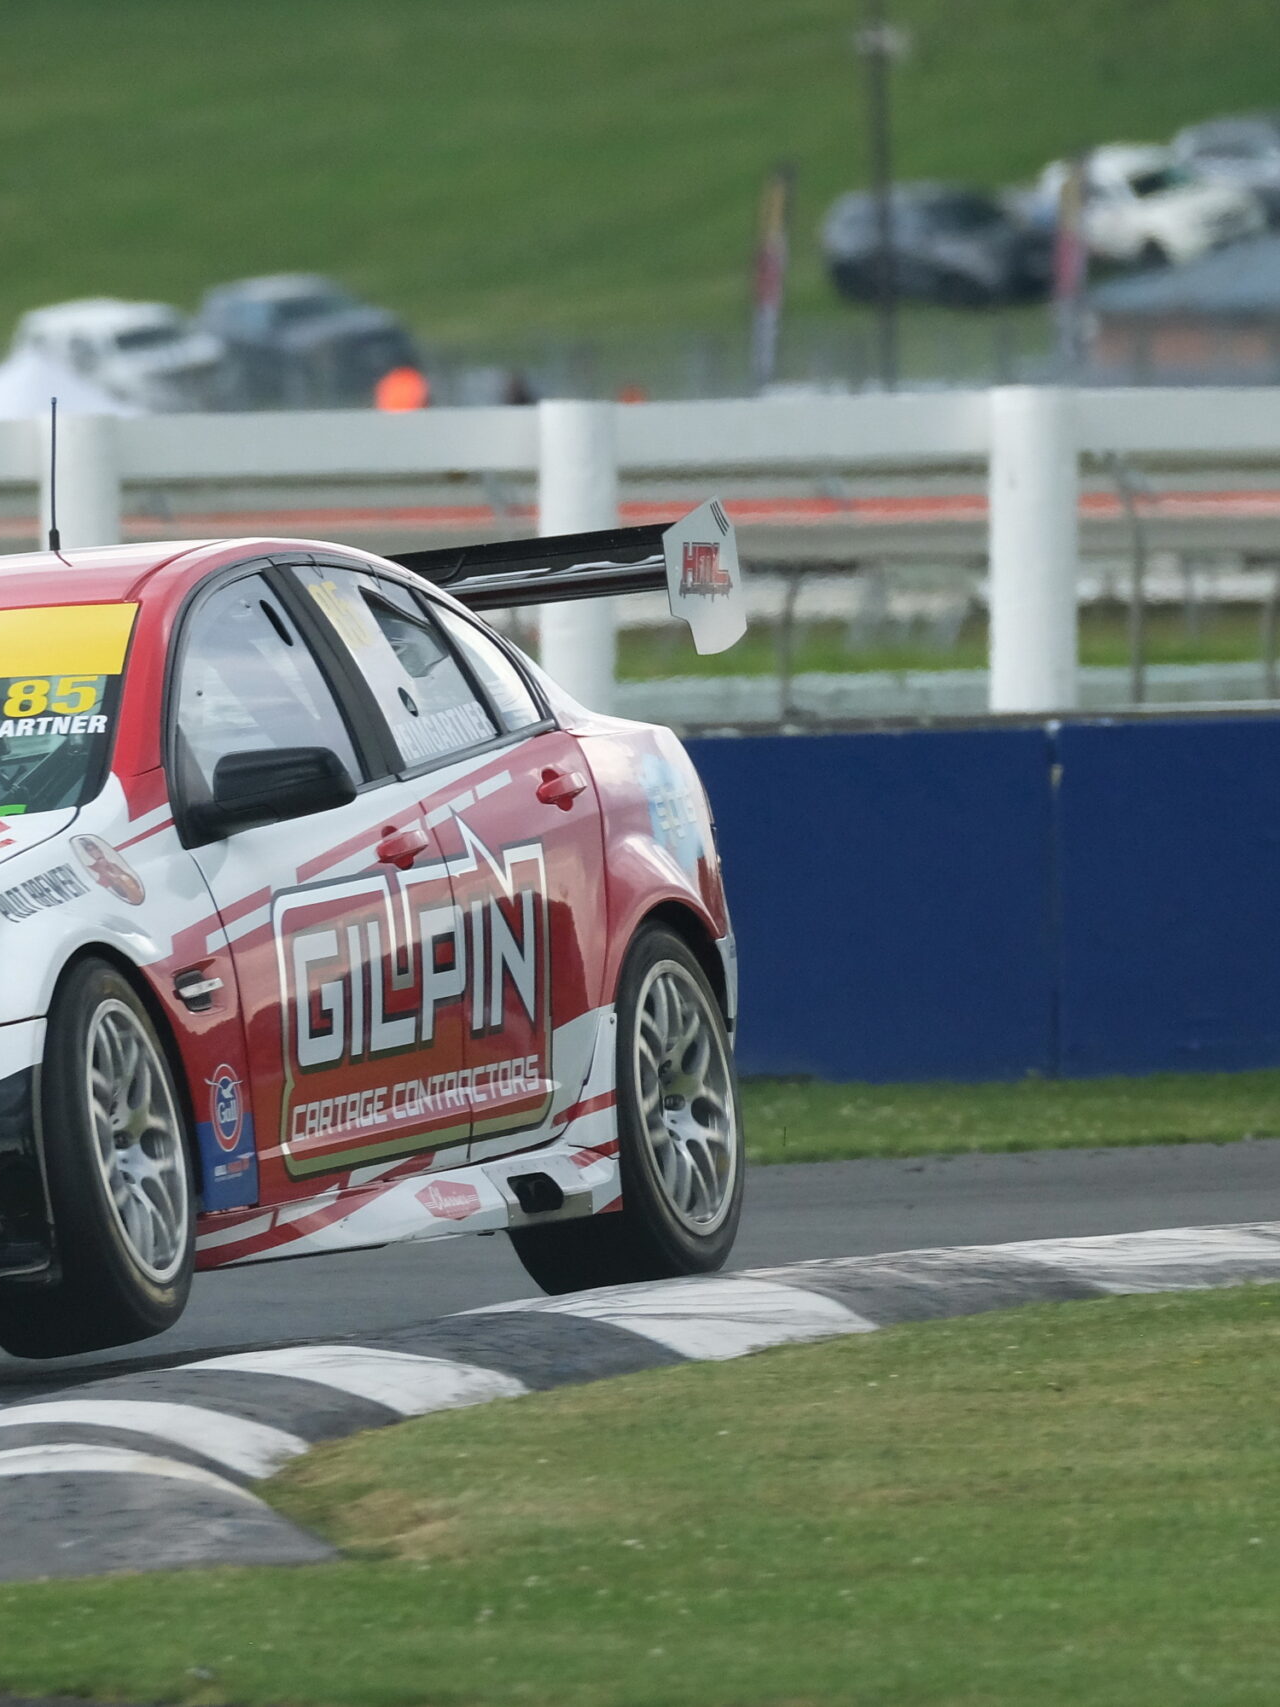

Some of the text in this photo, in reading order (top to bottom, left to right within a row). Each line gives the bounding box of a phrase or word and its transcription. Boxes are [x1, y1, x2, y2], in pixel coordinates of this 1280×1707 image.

[2, 675, 99, 718] 85
[292, 889, 538, 1068] GILPIN
[291, 1054, 540, 1143] CARTAGE CONTRACTORS
